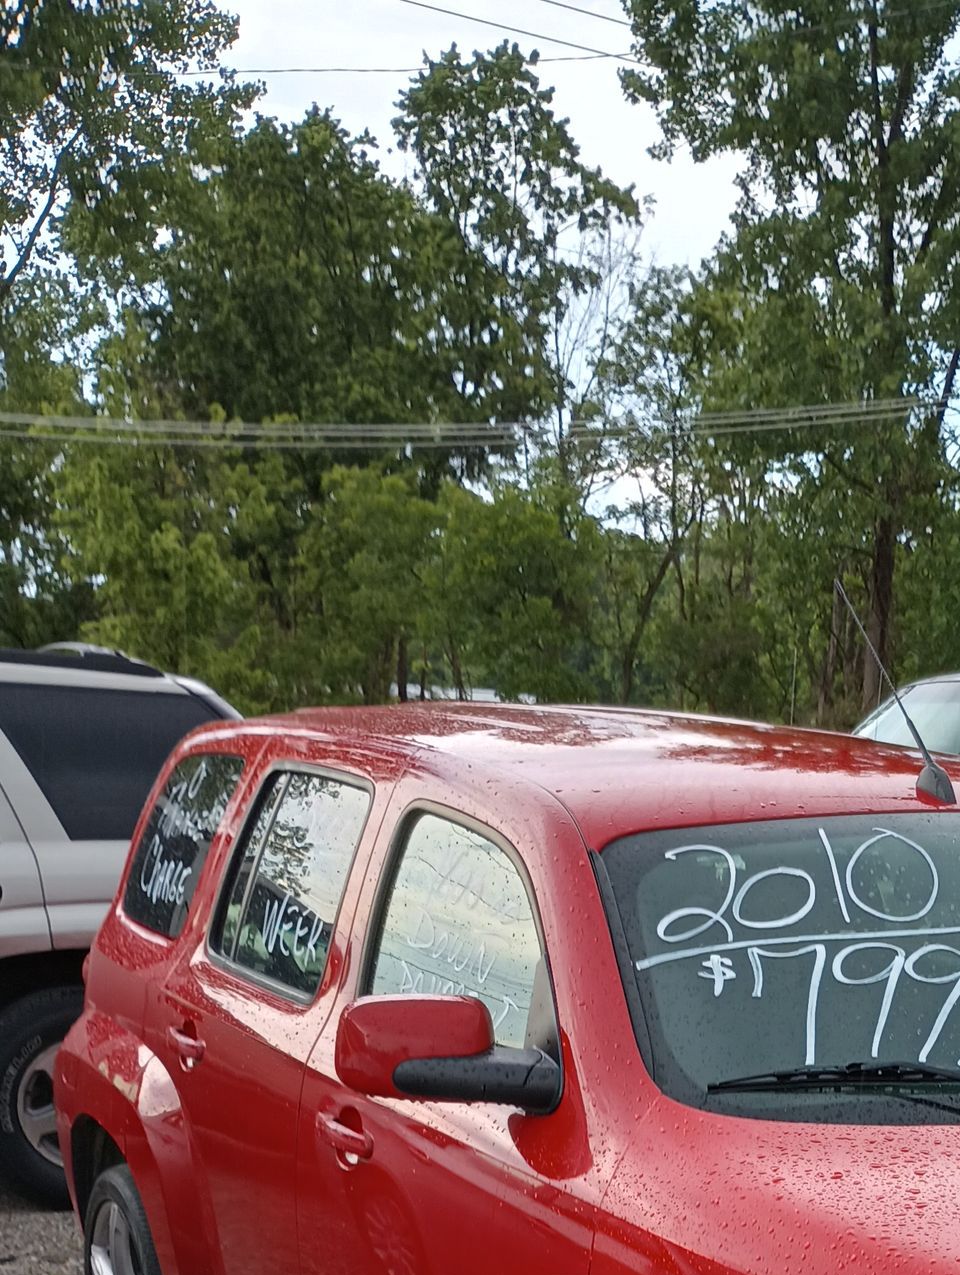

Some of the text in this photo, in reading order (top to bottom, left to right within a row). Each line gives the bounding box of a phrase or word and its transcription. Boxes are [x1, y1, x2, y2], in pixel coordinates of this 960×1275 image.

[656, 827, 939, 943] 2010
[262, 892, 323, 967] WEEK
[406, 906, 497, 984] DOWN
